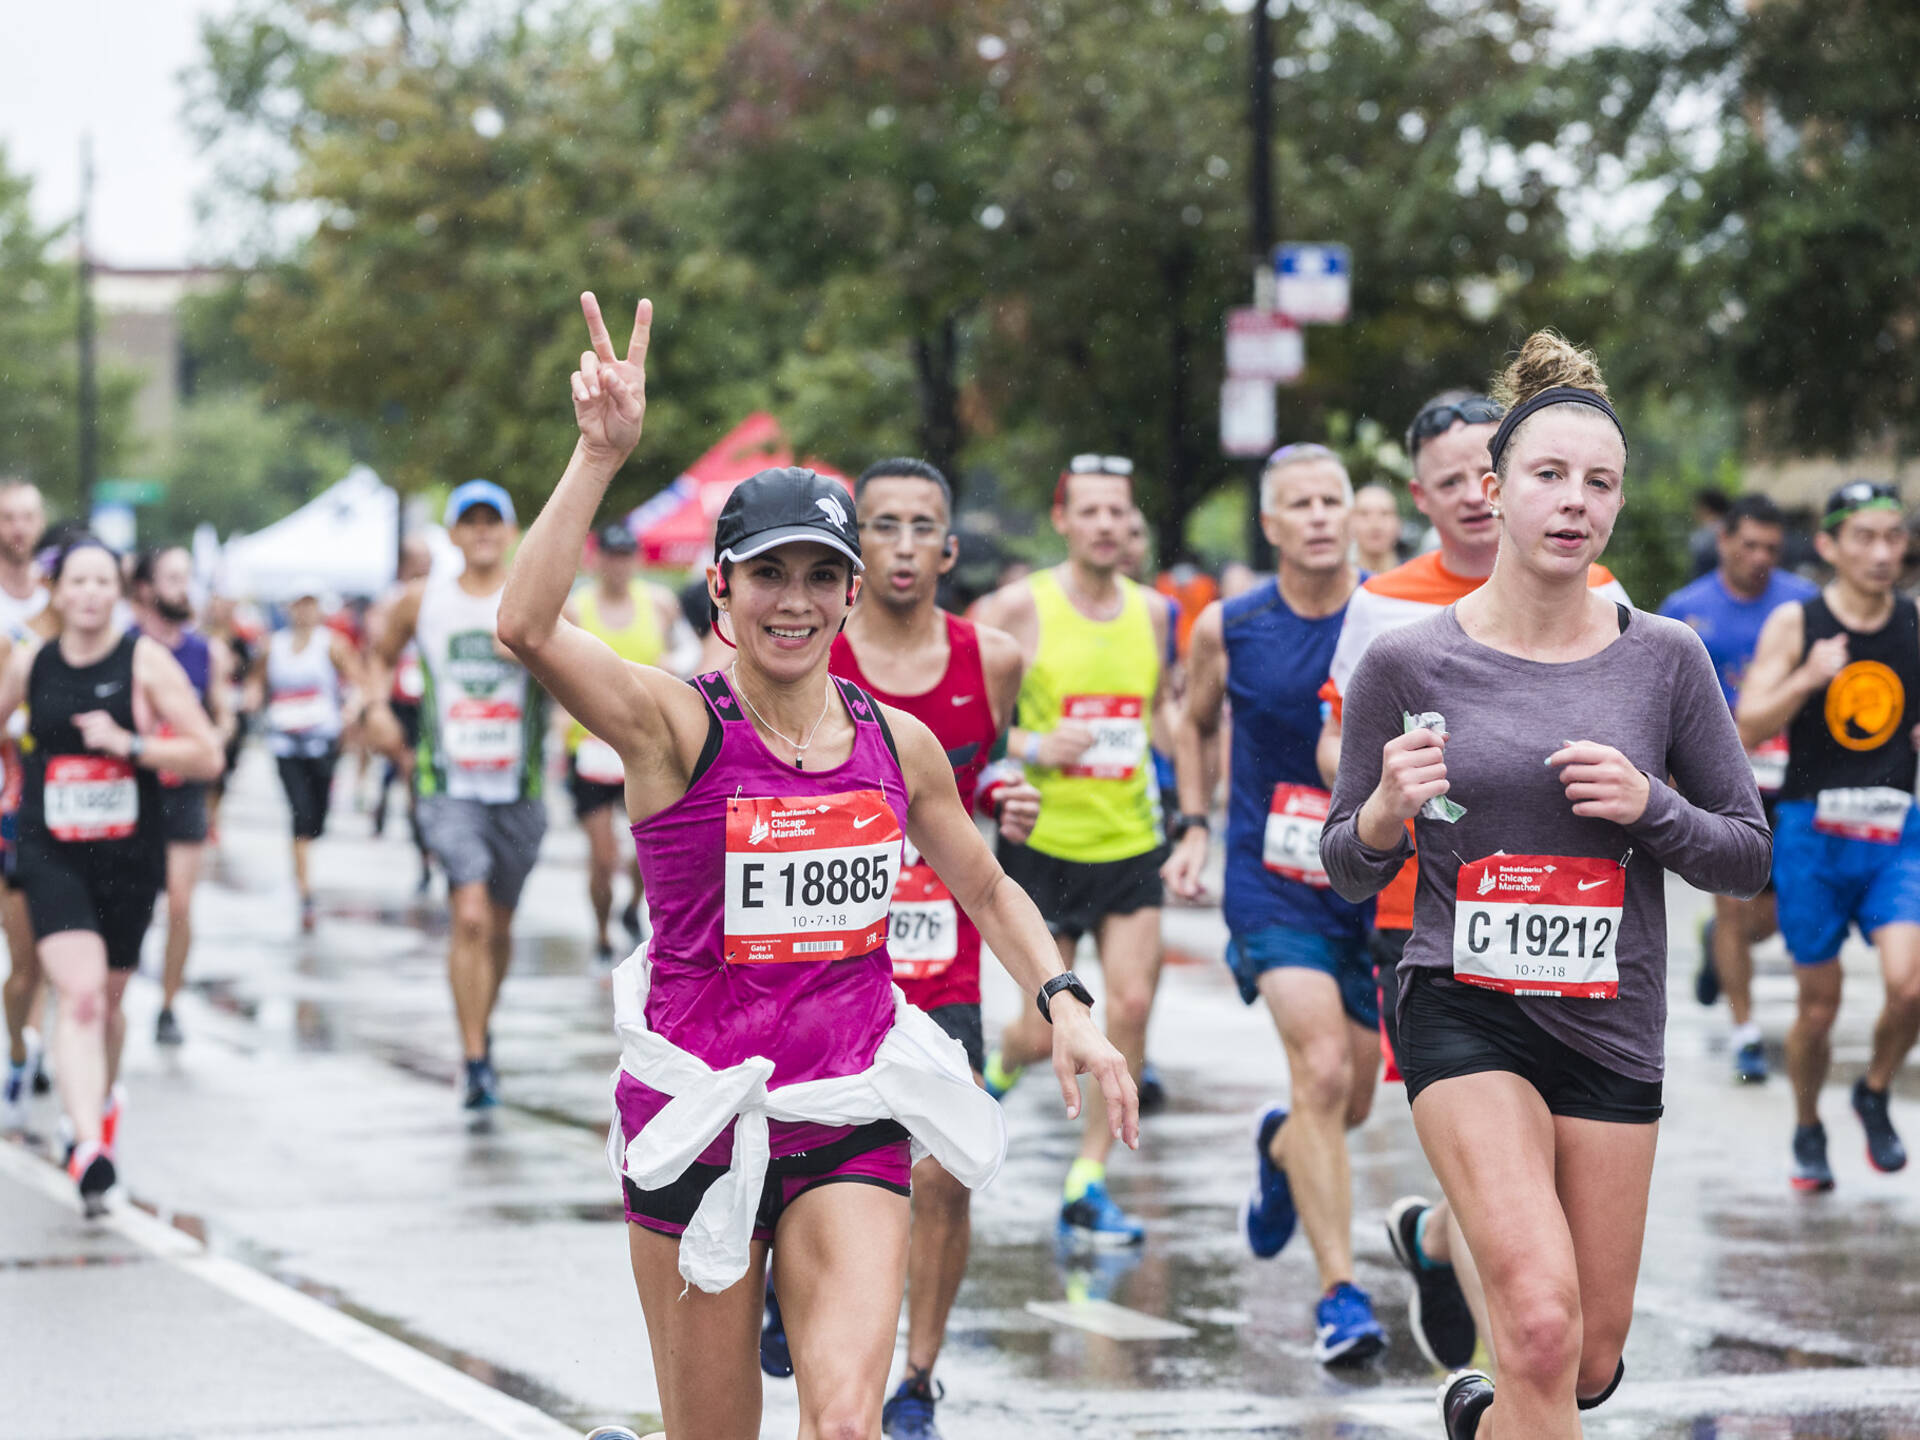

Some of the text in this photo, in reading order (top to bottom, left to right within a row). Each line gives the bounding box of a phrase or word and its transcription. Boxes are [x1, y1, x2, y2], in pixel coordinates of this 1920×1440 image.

[771, 819, 806, 830] Chicago
[771, 827, 815, 838] Marathon
[742, 854, 888, 908] E 18885
[1499, 873, 1533, 884] Chicago
[1499, 882, 1541, 892] Marathon
[889, 911, 941, 940] 676
[1468, 911, 1612, 959] C 19212
[748, 952, 774, 960] Jackson
